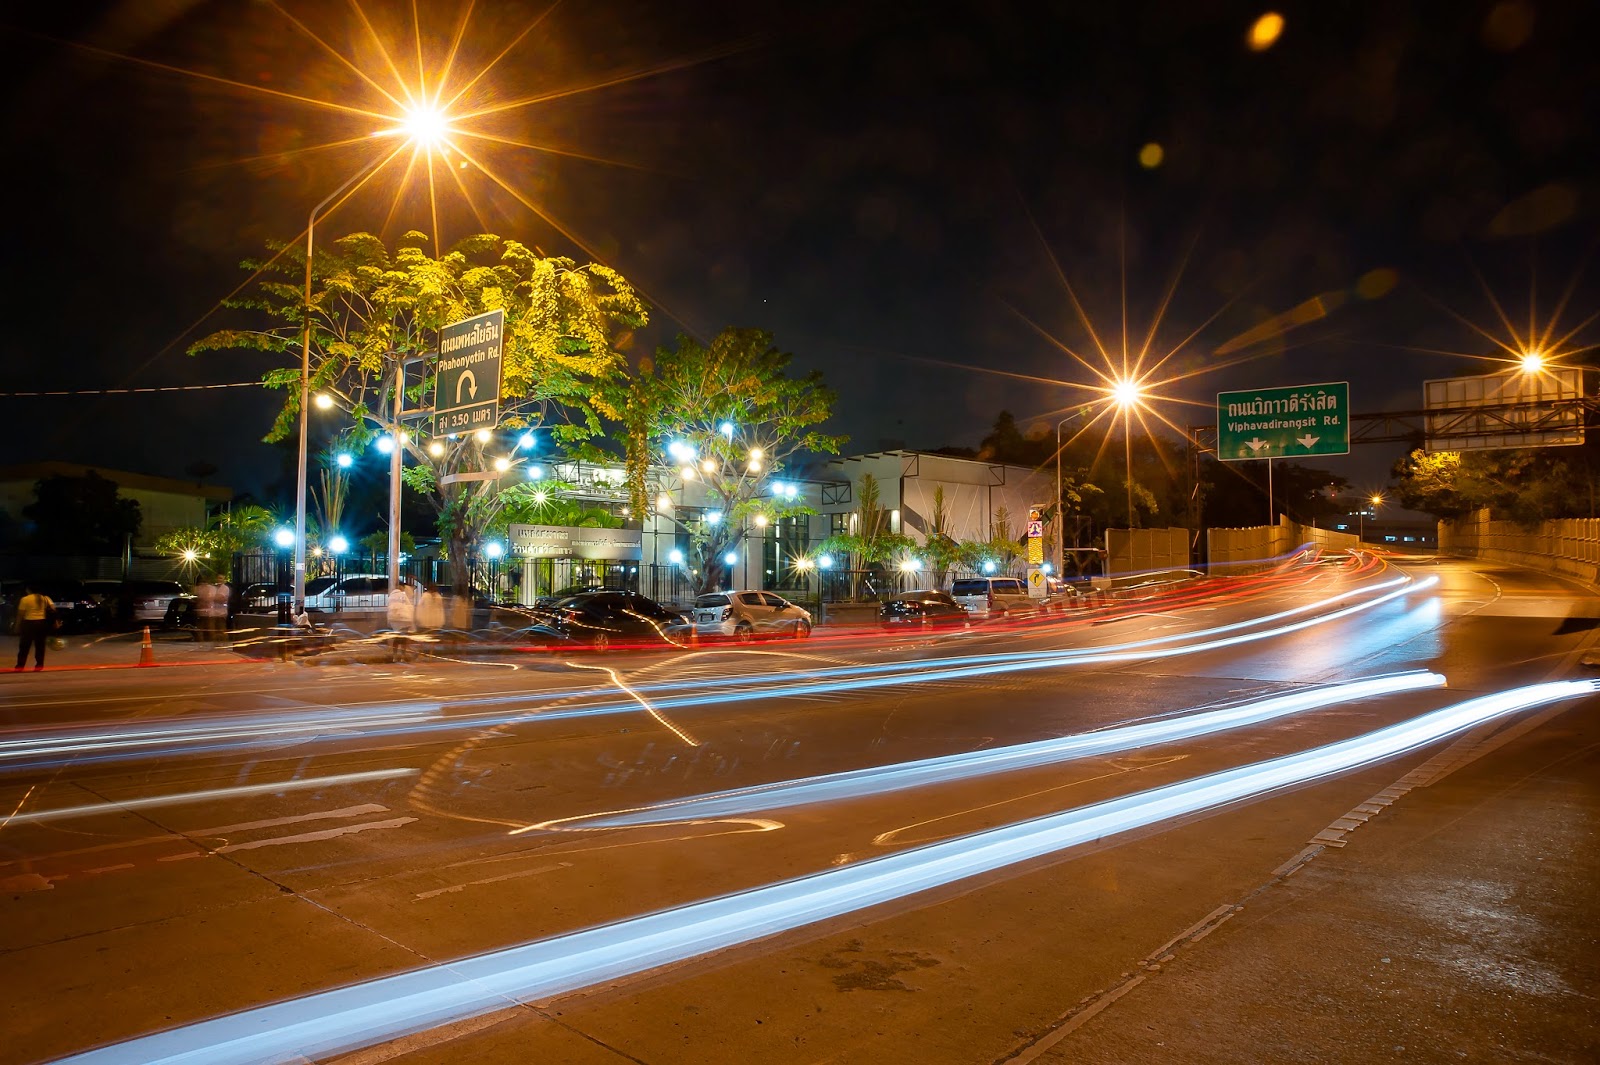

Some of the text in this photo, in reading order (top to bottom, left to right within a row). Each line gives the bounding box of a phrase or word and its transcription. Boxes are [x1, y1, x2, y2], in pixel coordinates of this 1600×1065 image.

[441, 321, 499, 354] ถนนพหลโยธิน
[438, 346, 500, 372] Phahonyotin Rd.
[1228, 390, 1337, 417] ถนนวิภาวดีรังสิต
[439, 408, 491, 433] สูง 3.50 เมตร
[1227, 415, 1341, 433] Viphavadirangsit Rd.
